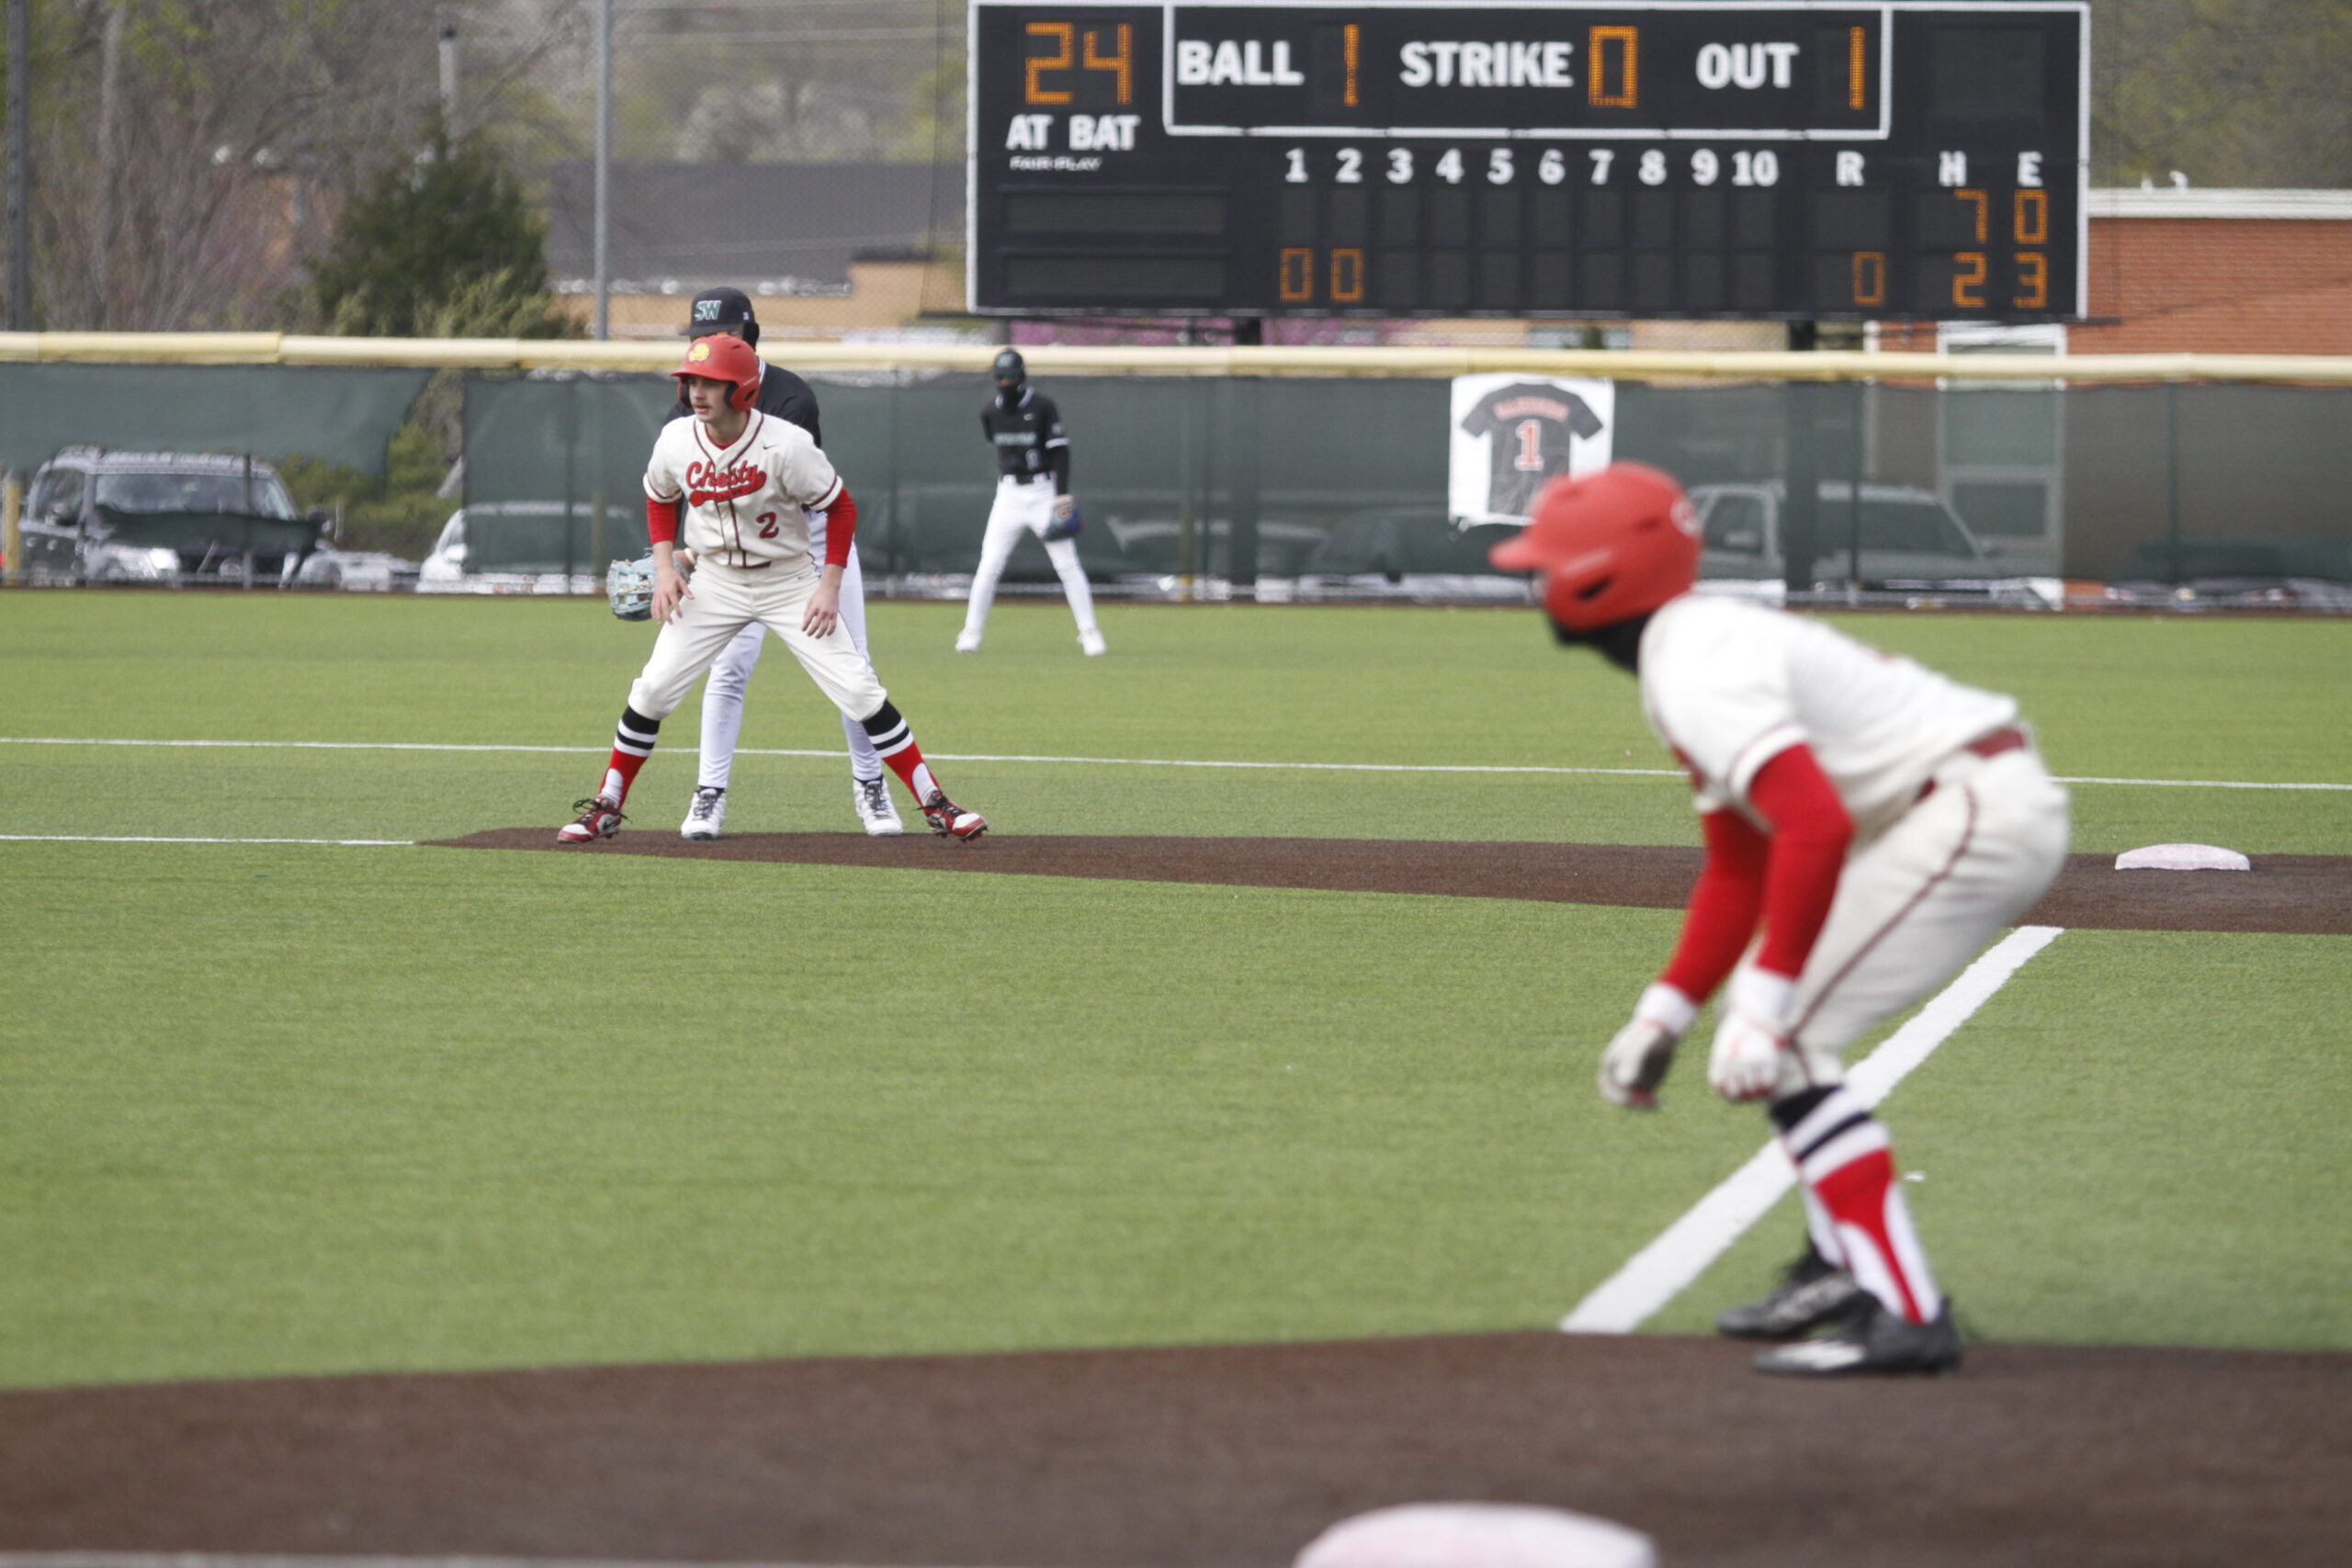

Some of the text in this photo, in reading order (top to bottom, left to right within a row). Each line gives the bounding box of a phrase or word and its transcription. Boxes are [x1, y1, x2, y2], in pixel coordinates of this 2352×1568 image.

[1026, 22, 1131, 104] 24
[1178, 24, 1864, 109] BALL 1 STRIKE 0 OUT 1
[1006, 115, 1140, 150] AT BAT
[1286, 149, 2041, 186] 1 2 3 4 5 6 7 8 9 10 R H E
[1955, 189, 2047, 243] 7 0
[1282, 249, 2047, 308] 0 0 0 2 3
[694, 299, 721, 321] SW
[1514, 419, 1544, 470] 1
[685, 460, 766, 491] Chesty
[756, 512, 779, 539] 2
